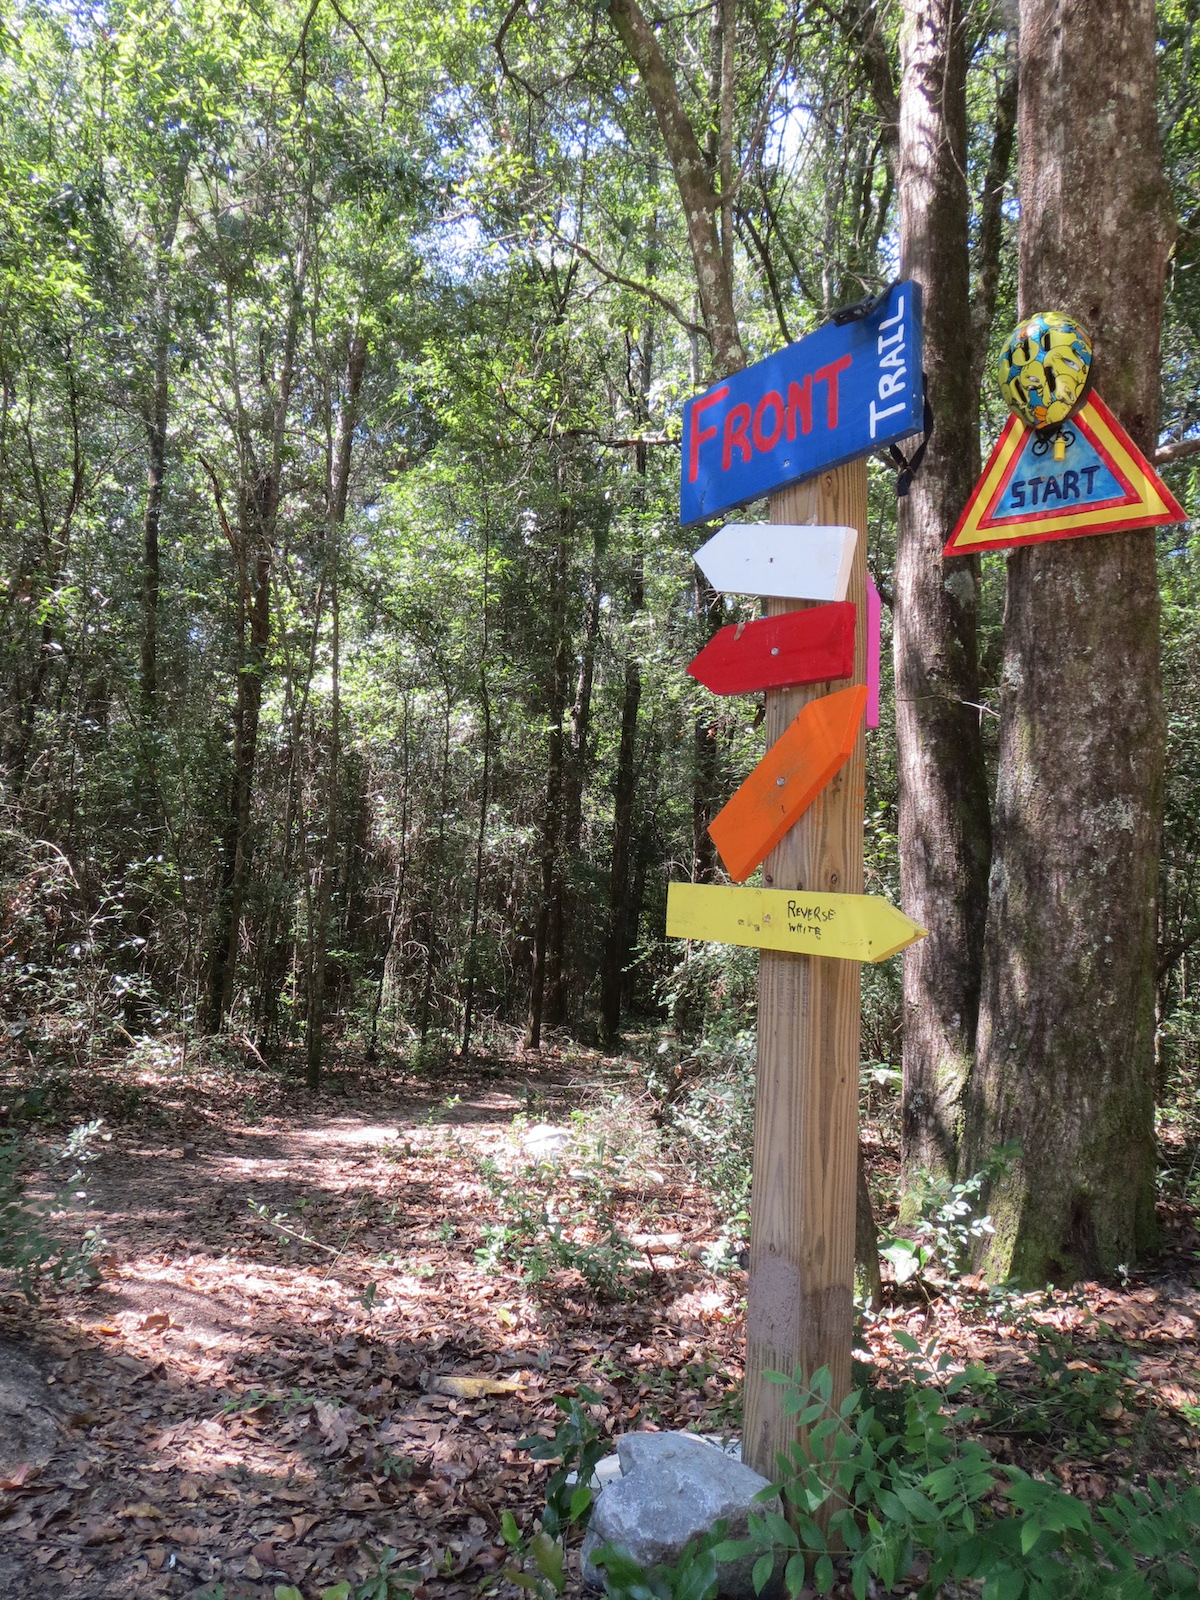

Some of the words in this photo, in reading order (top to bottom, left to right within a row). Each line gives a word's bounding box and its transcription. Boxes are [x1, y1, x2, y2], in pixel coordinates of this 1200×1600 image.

[868, 295, 907, 439] TRAIL
[688, 354, 853, 483] FRONT
[1010, 465, 1101, 509] START
[787, 900, 836, 922] REVERSE
[788, 922, 822, 937] WHITE
